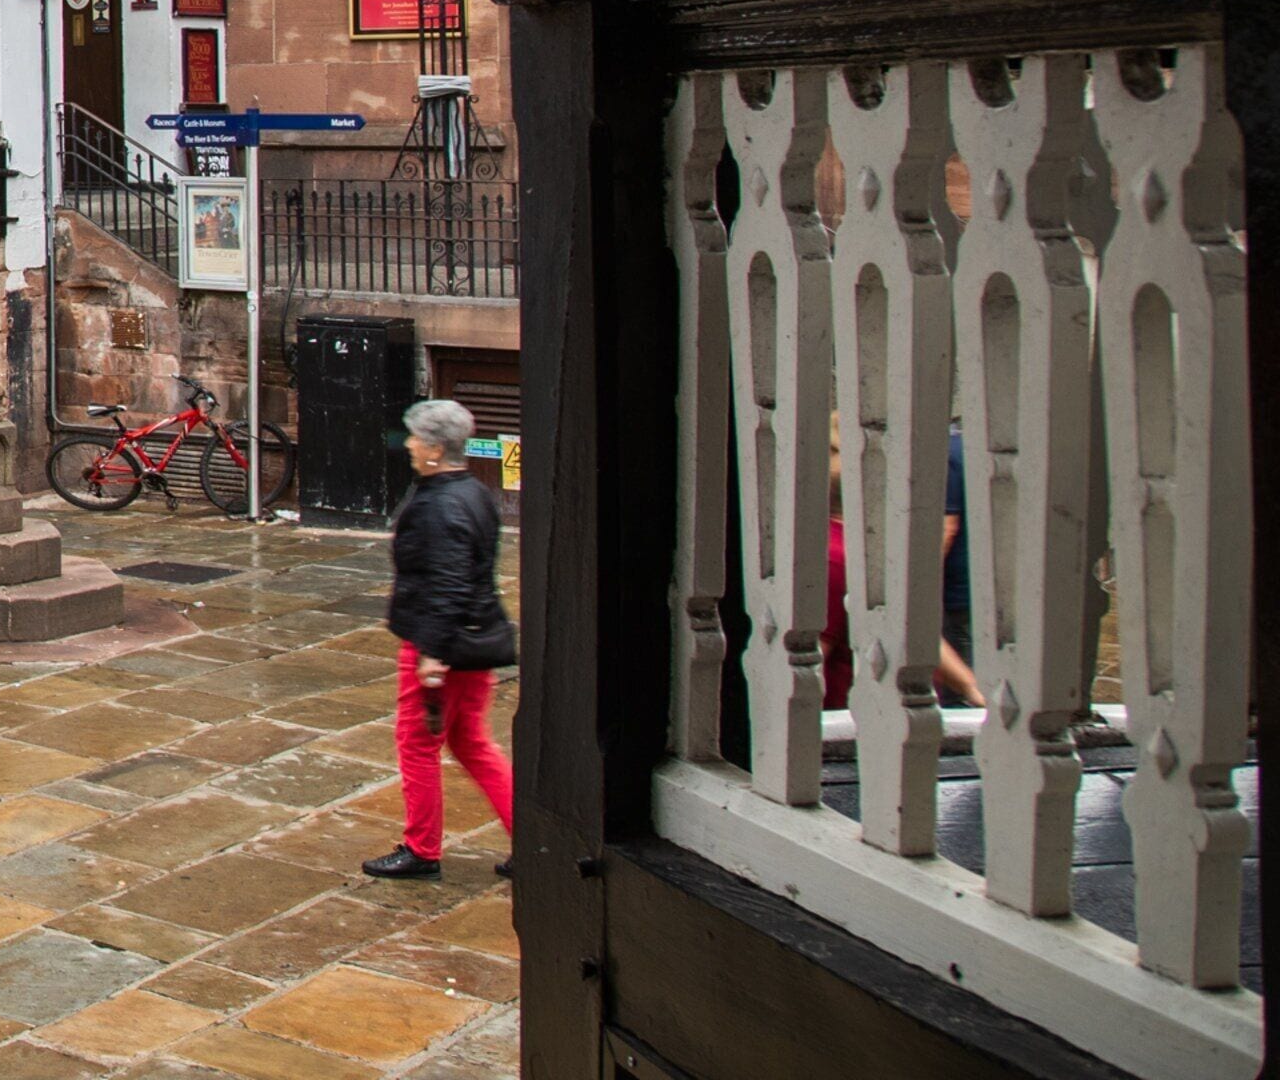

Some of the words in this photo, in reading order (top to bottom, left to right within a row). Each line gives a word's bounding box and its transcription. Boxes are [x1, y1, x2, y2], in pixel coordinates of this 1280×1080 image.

[153, 119, 176, 127] Raceco
[184, 119, 197, 128] Castle
[198, 119, 203, 127] &
[204, 119, 226, 127] Museums
[331, 118, 355, 127] Market
[185, 135, 193, 143] The
[194, 135, 206, 143] River
[212, 135, 220, 143] The
[220, 134, 237, 143] Groves
